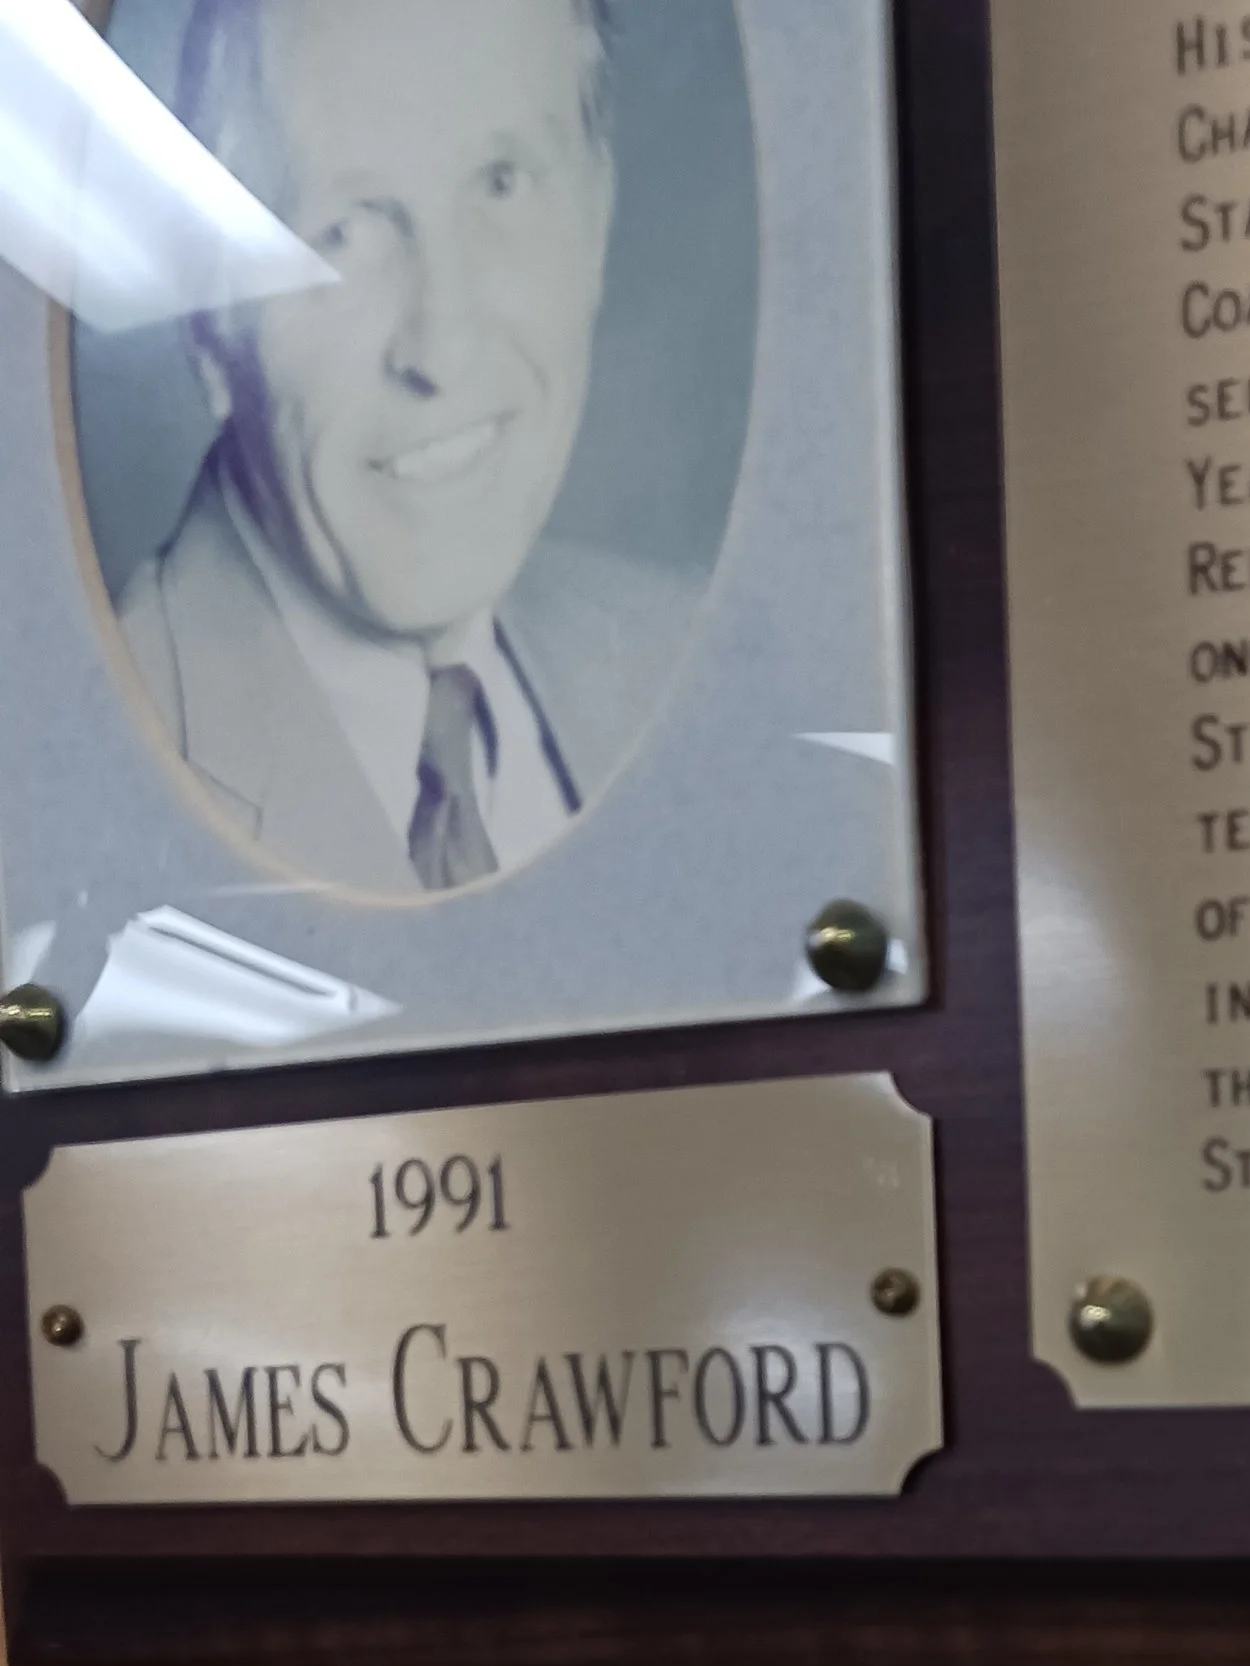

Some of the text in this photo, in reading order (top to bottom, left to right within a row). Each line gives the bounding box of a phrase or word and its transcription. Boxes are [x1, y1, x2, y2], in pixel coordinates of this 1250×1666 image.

[367, 1153, 513, 1241] 1991
[93, 1322, 872, 1465] JAMES CRAWFORD
